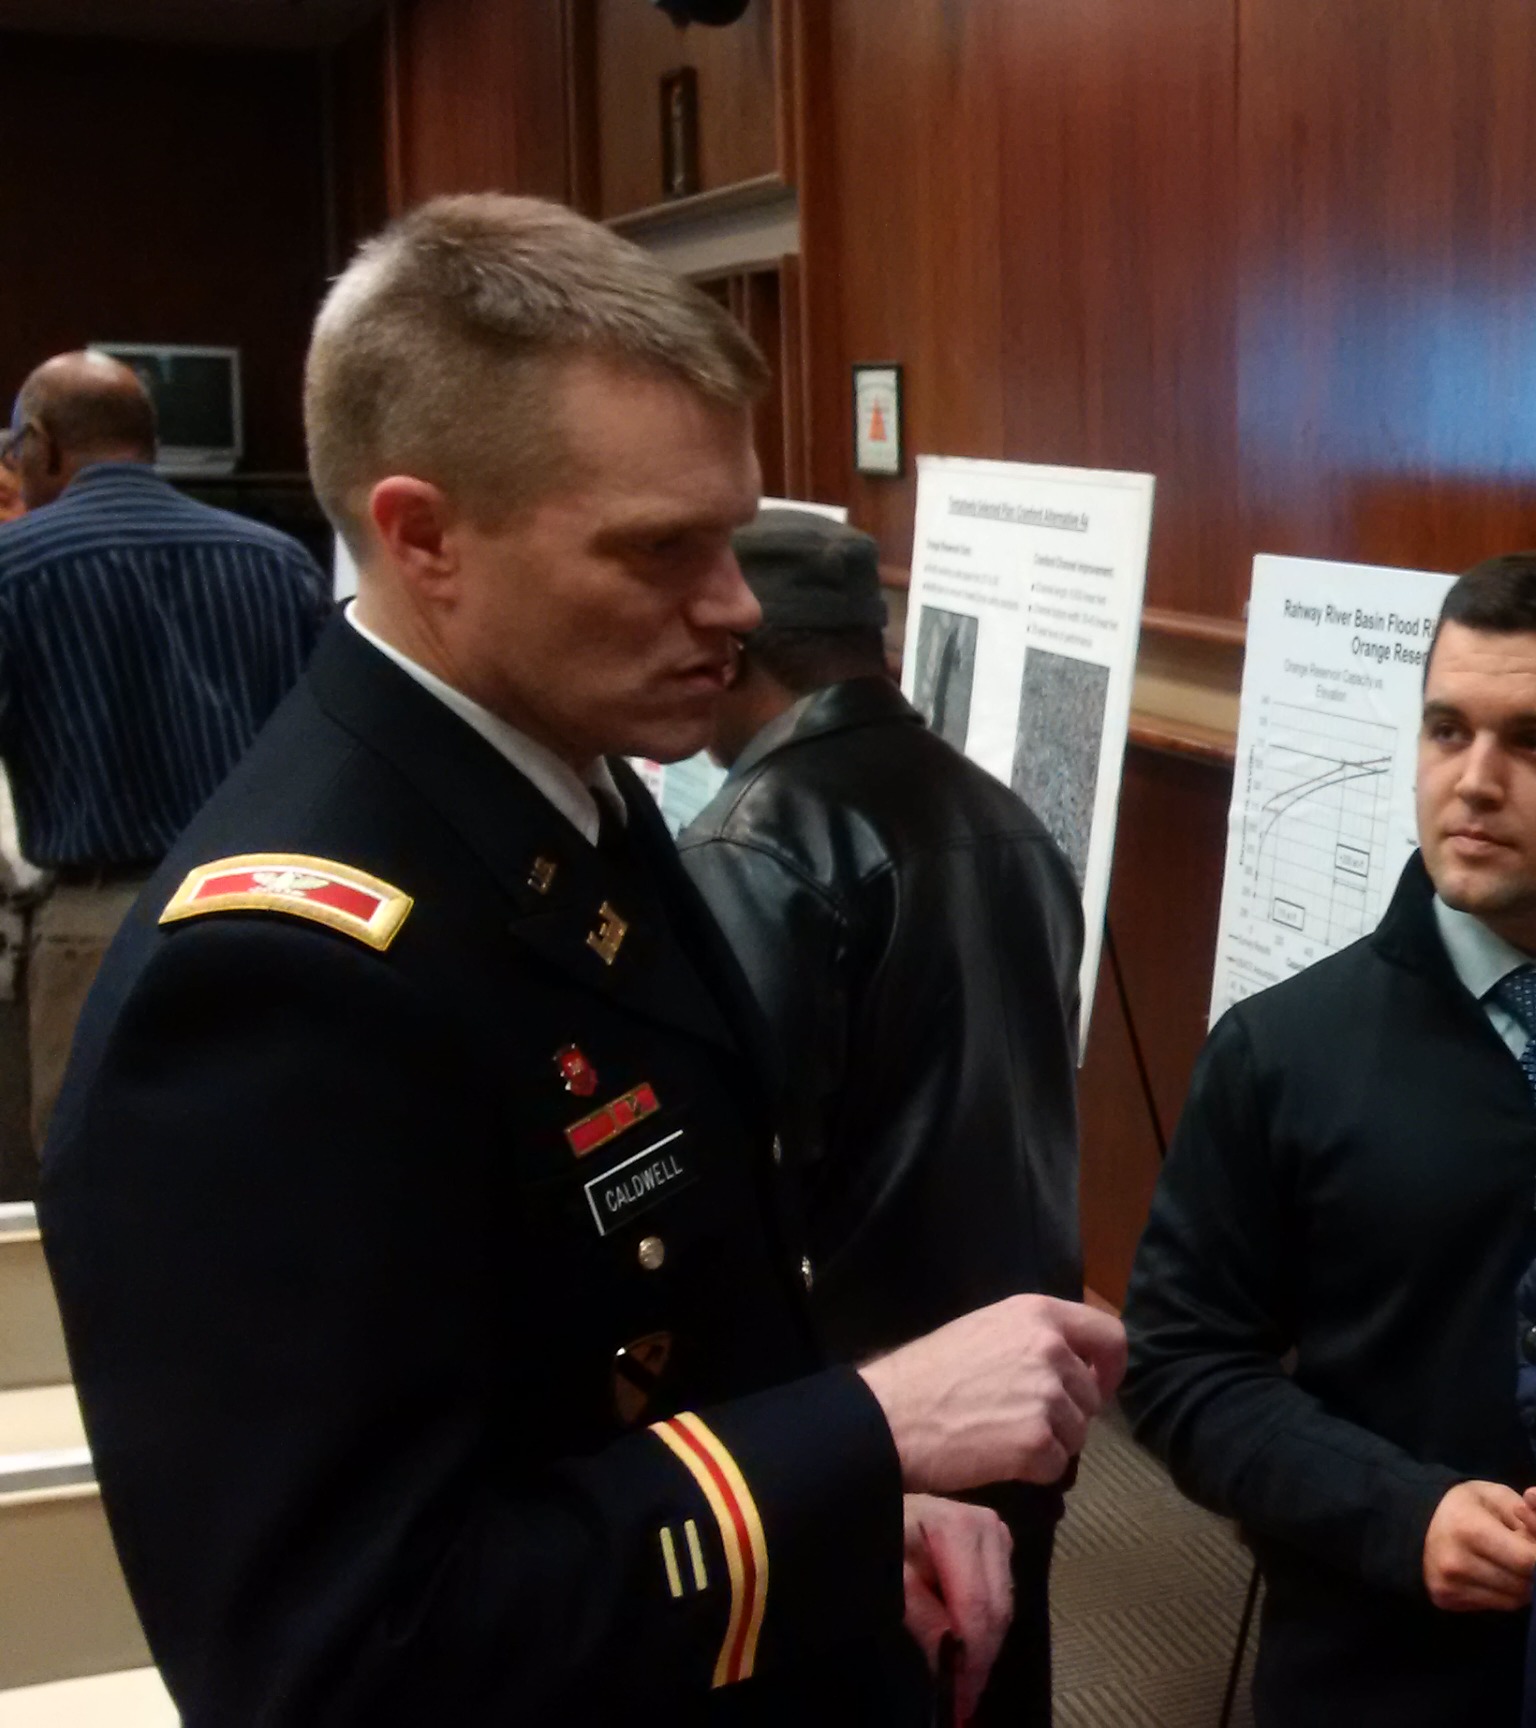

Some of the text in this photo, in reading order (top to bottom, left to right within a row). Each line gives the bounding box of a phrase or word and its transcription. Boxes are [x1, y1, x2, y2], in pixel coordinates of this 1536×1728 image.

[1284, 599, 1436, 639] Rahway River Basin Flood Ri
[1352, 636, 1427, 667] Orange Reser
[605, 1155, 683, 1212] CALDWELL
